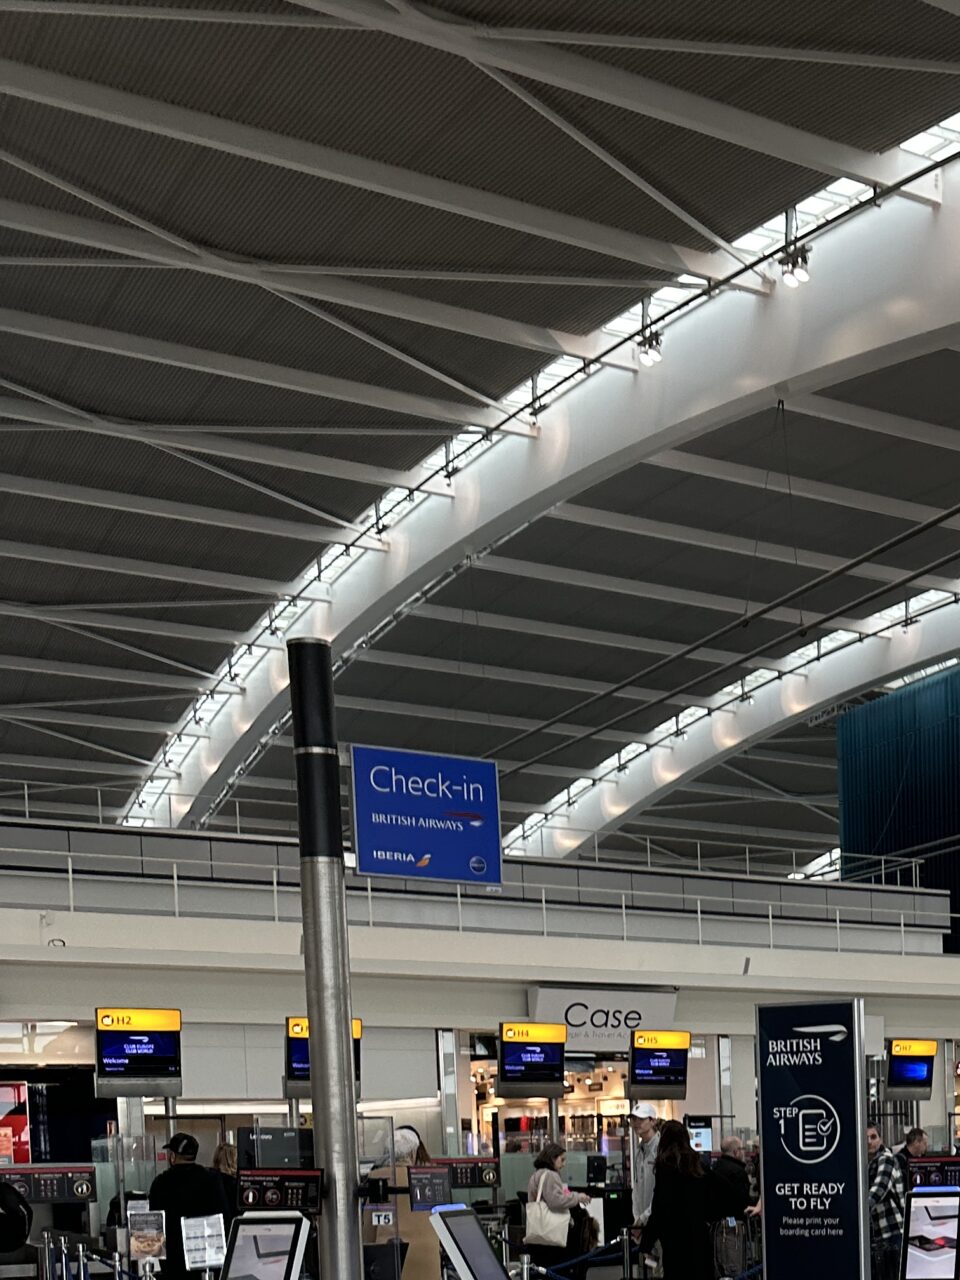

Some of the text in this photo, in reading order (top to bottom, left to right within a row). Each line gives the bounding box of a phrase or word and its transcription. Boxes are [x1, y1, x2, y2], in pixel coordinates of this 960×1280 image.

[370, 765, 483, 802] Check-in
[371, 812, 464, 831] BRITISH AIRWAYS
[373, 850, 415, 862] IBERIA
[116, 1015, 132, 1025] H2
[565, 1002, 642, 1029] Case
[768, 1038, 820, 1053] BRITISH
[766, 1052, 822, 1067] AIRWAYS
[773, 1107, 799, 1118] STEP
[778, 1118, 785, 1135] 1
[775, 1182, 845, 1195] GET READY
[789, 1197, 831, 1210] TO FLY
[374, 1213, 391, 1225] T5
[782, 1216, 840, 1226] Please print your
[779, 1227, 843, 1237] boarding card here
